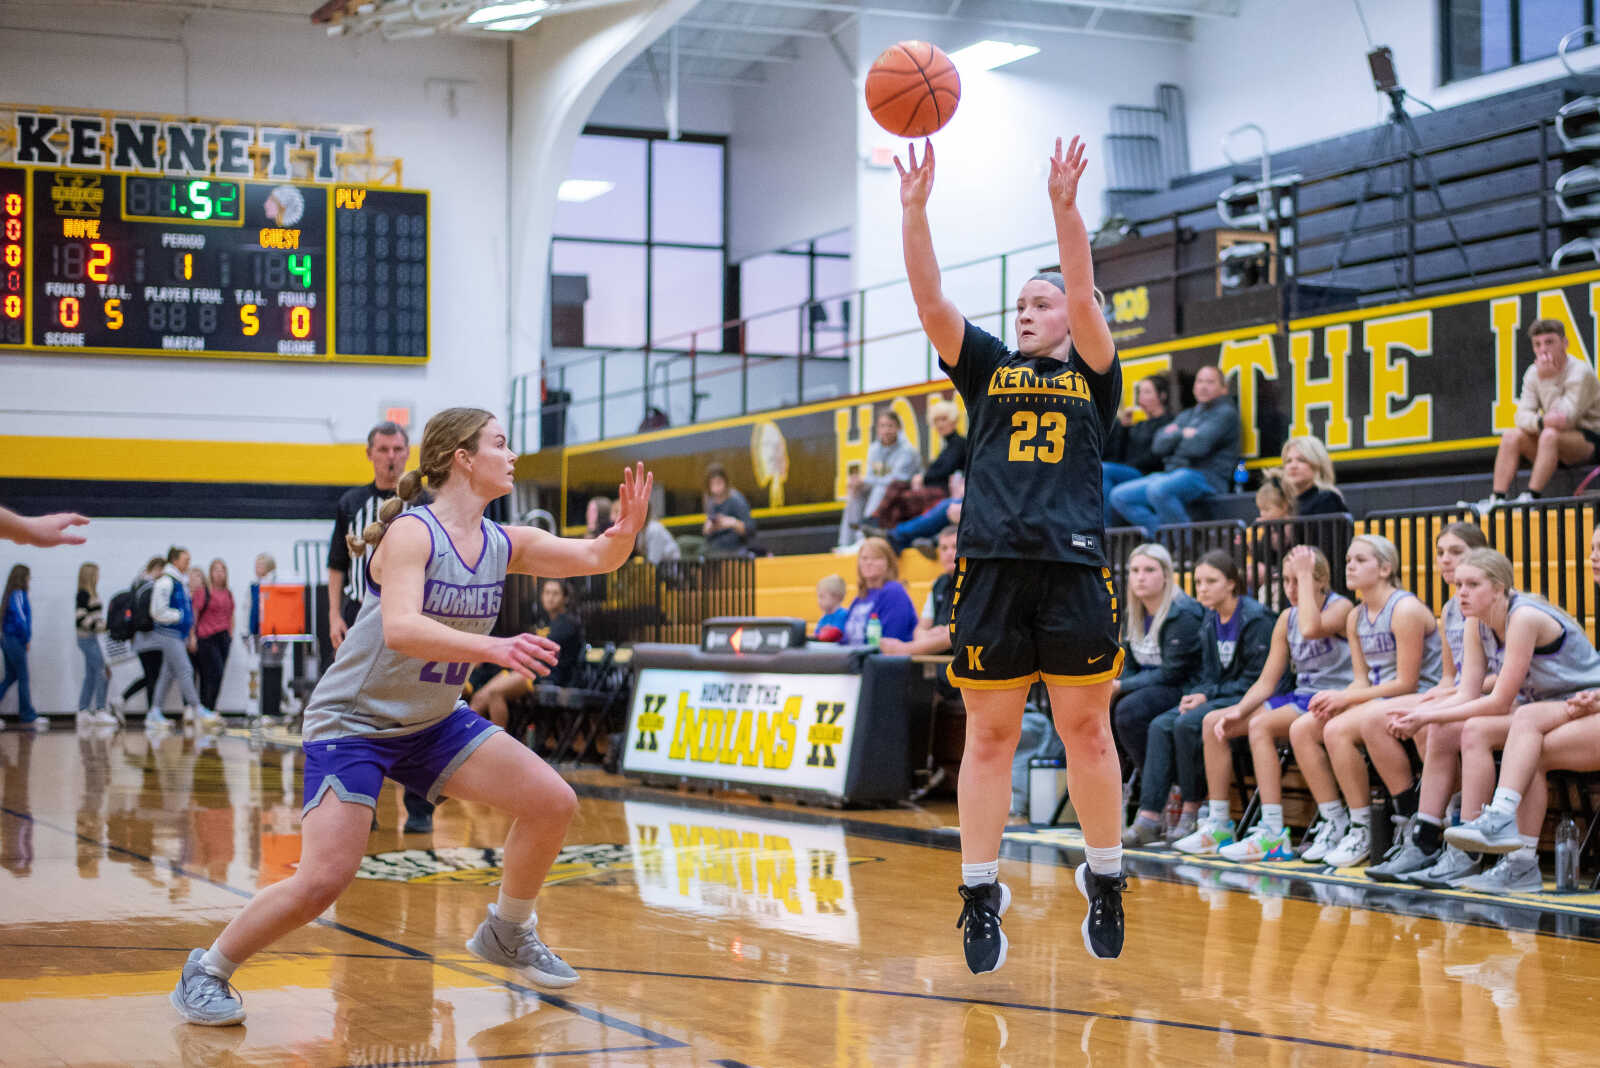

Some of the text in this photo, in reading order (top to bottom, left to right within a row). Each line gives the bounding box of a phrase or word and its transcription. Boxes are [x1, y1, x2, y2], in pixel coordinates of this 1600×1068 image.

[14, 112, 345, 183] KENNETT
[335, 188, 366, 209] PLY
[63, 218, 101, 239] HOME
[161, 233, 205, 249] PERIOD
[259, 228, 301, 249] GUEST
[87, 243, 112, 282] 2
[183, 253, 193, 280] 1
[287, 254, 312, 288] 4
[45, 282, 86, 298] FOULS
[144, 286, 190, 302] PLAYER
[192, 288, 225, 305] FOUL
[277, 291, 316, 308] FOULS
[59, 297, 80, 328] 0
[289, 306, 312, 339] 0
[44, 332, 316, 356] SCORE MATCH SCORE
[992, 370, 1089, 396] KENNETT
[1218, 310, 1433, 458] THE
[1008, 410, 1067, 464] 23
[423, 583, 504, 616] HORNETS
[965, 645, 985, 671] K
[701, 682, 781, 705] HOME OF THE
[635, 694, 667, 751] K
[668, 690, 803, 770] INDIANS
[806, 702, 846, 768] K
